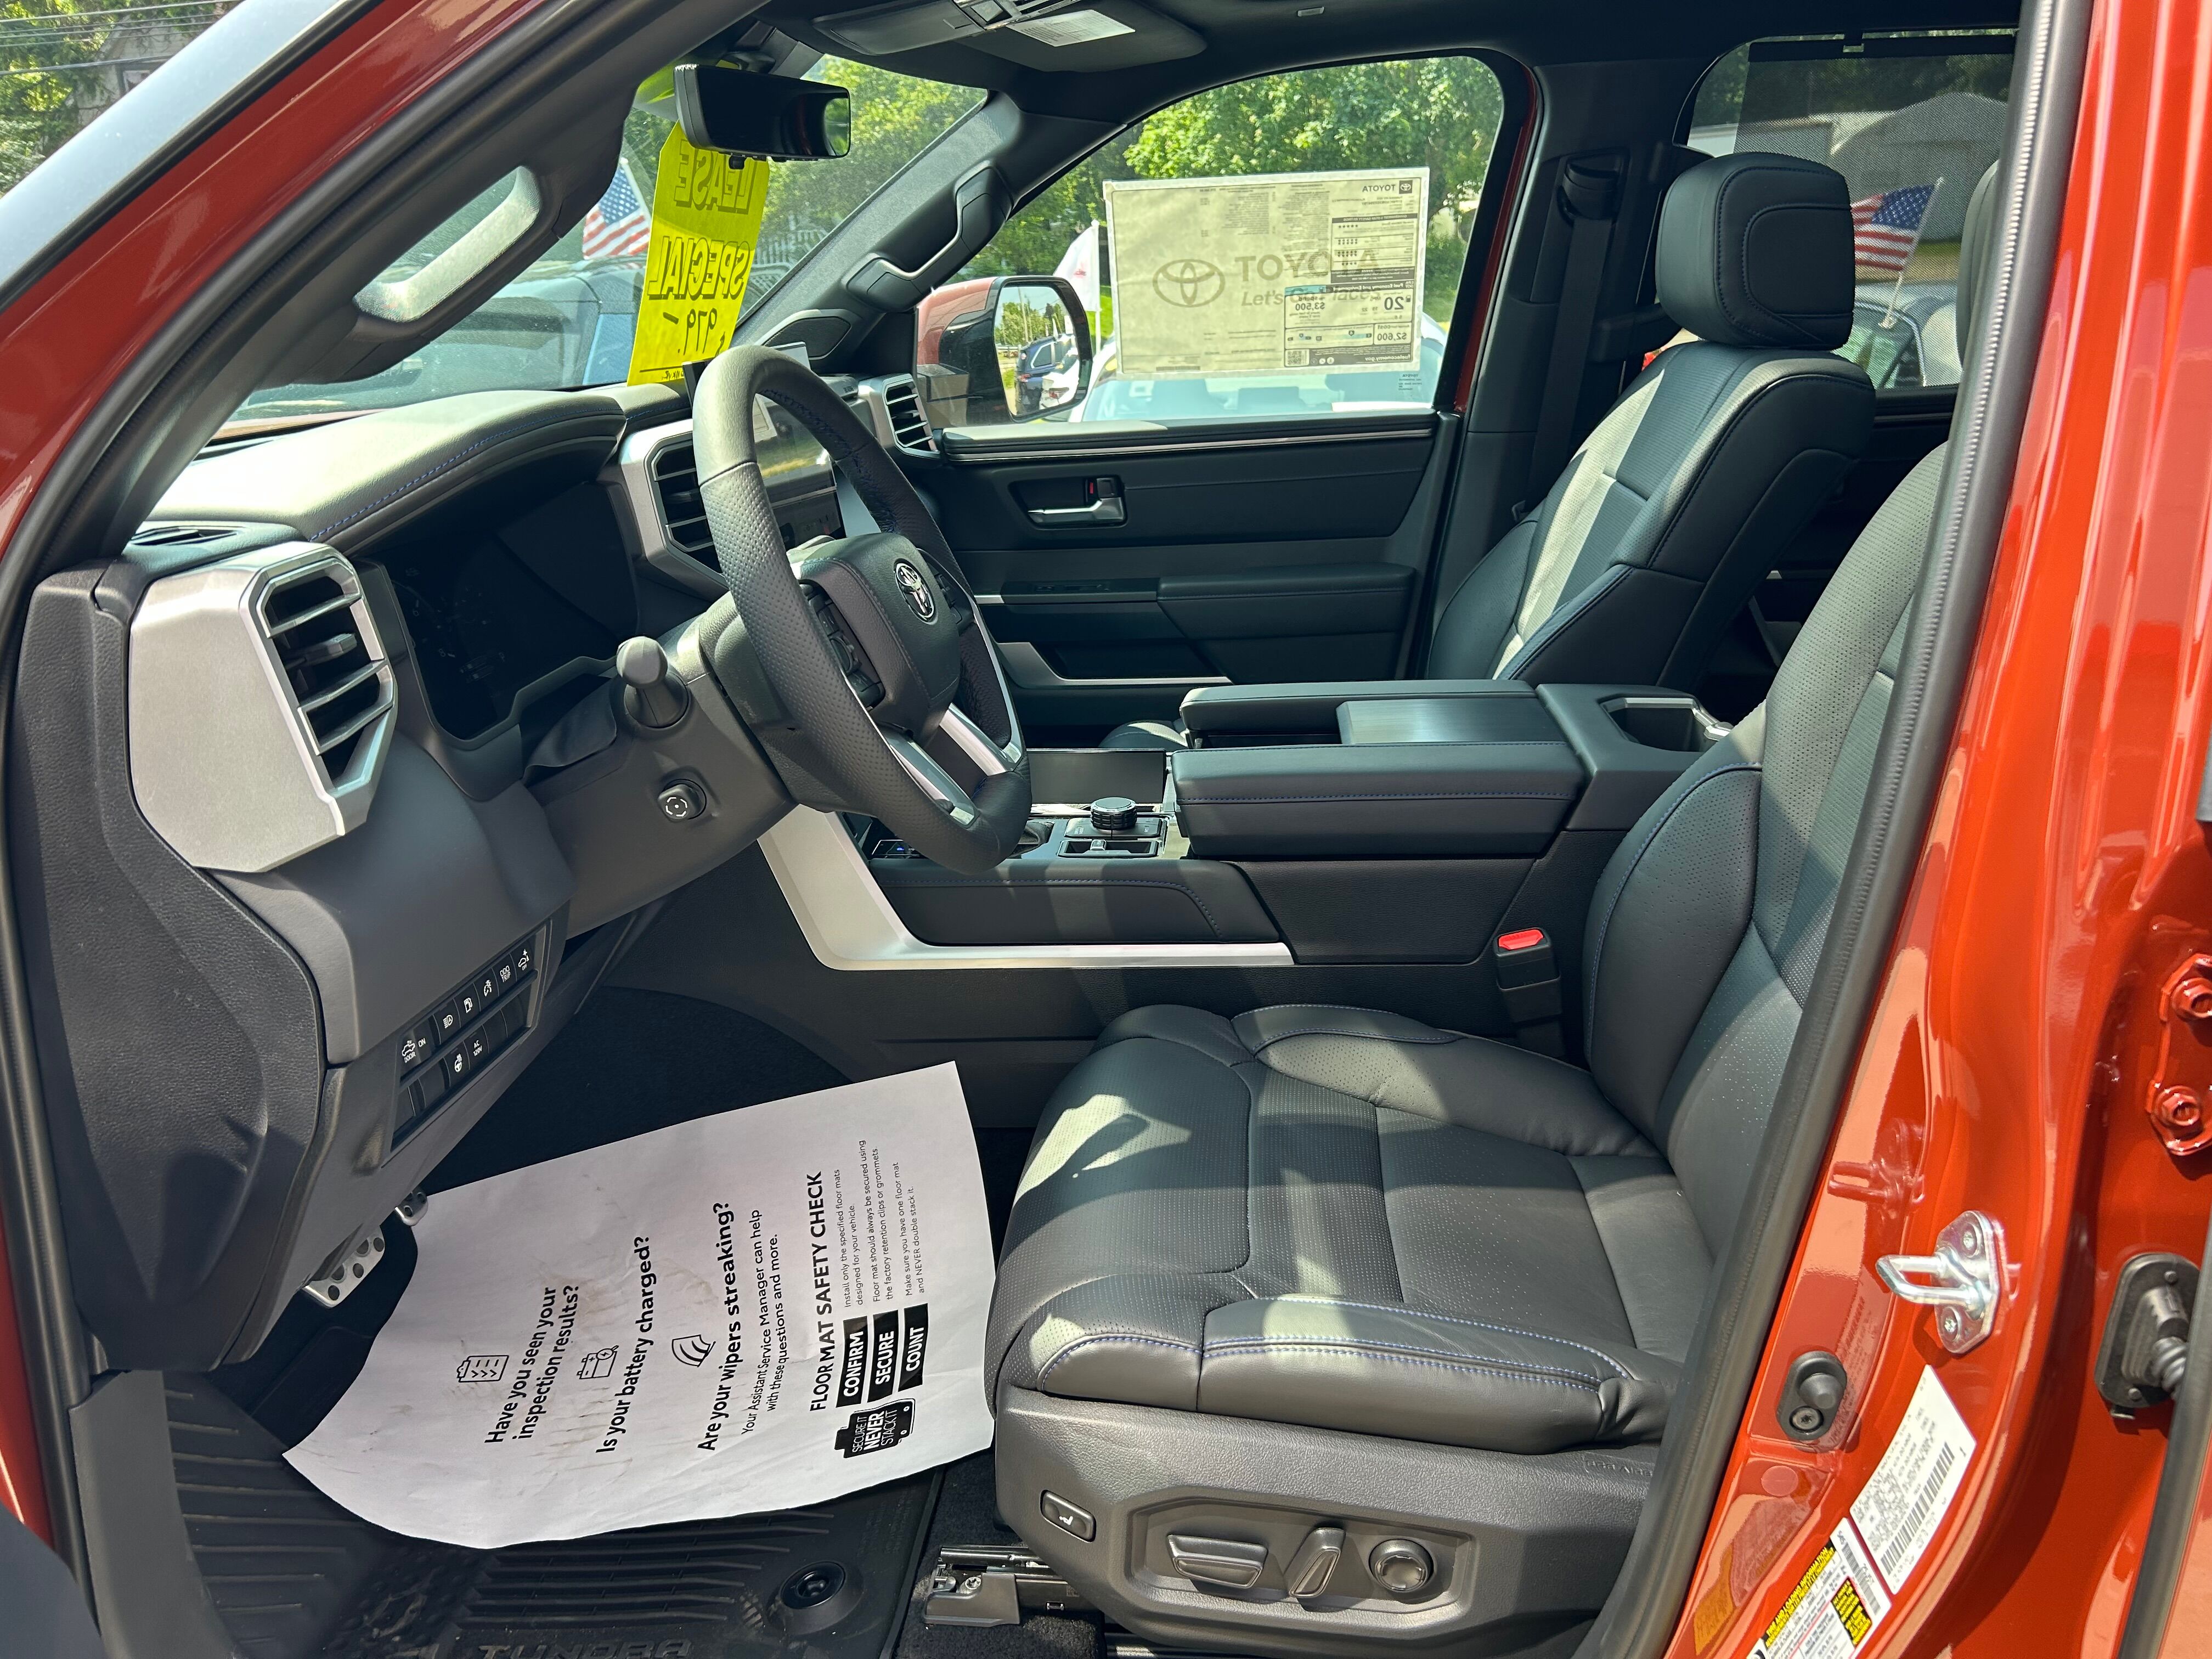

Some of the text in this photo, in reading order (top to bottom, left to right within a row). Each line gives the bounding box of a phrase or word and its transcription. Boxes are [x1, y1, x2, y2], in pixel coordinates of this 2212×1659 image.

[1241, 290, 1284, 306] Let's
[501, 972, 511, 983] TRIP
[417, 1037, 426, 1047] ON
[473, 1040, 480, 1048] AC
[861, 1163, 871, 1195] secured
[873, 1146, 884, 1189] grommets.
[865, 1196, 872, 1206] be
[878, 1199, 887, 1220] clips
[908, 1196, 917, 1216] stack
[837, 1211, 847, 1247] specified
[866, 1207, 875, 1234] always
[910, 1218, 919, 1246] double
[851, 1234, 860, 1254] your
[867, 1235, 877, 1263] should
[879, 1221, 889, 1256] retention
[902, 1239, 911, 1254] you
[840, 1263, 850, 1280] only
[871, 1263, 879, 1279] mat
[883, 1257, 892, 1284] factory
[913, 1248, 923, 1277] NEVER
[806, 1171, 836, 1412] FLOOR MAT SAFETY CHECK
[841, 1281, 851, 1307] Install
[853, 1267, 864, 1305] designed
[885, 1285, 894, 1300] the
[904, 1274, 913, 1296] Make
[915, 1277, 925, 1293] and
[697, 1203, 743, 1451] Are your wipers streaking?
[741, 1210, 771, 1435] Your Assistant Service Manager can help
[766, 1234, 789, 1412] with these questions and more.
[596, 1236, 657, 1453] Is your battery charged?
[875, 1330, 895, 1385] SECURE
[906, 1327, 924, 1372] COUNT
[484, 1287, 556, 1443] Have you seen your
[512, 1285, 579, 1440] inspection results?
[843, 1330, 864, 1397] CONFIRM
[852, 1423, 867, 1452] SECURE
[864, 1410, 884, 1450] NEVER
[881, 1409, 898, 1446] STACK IT
[1620, 1465, 1654, 1477] AIRB
